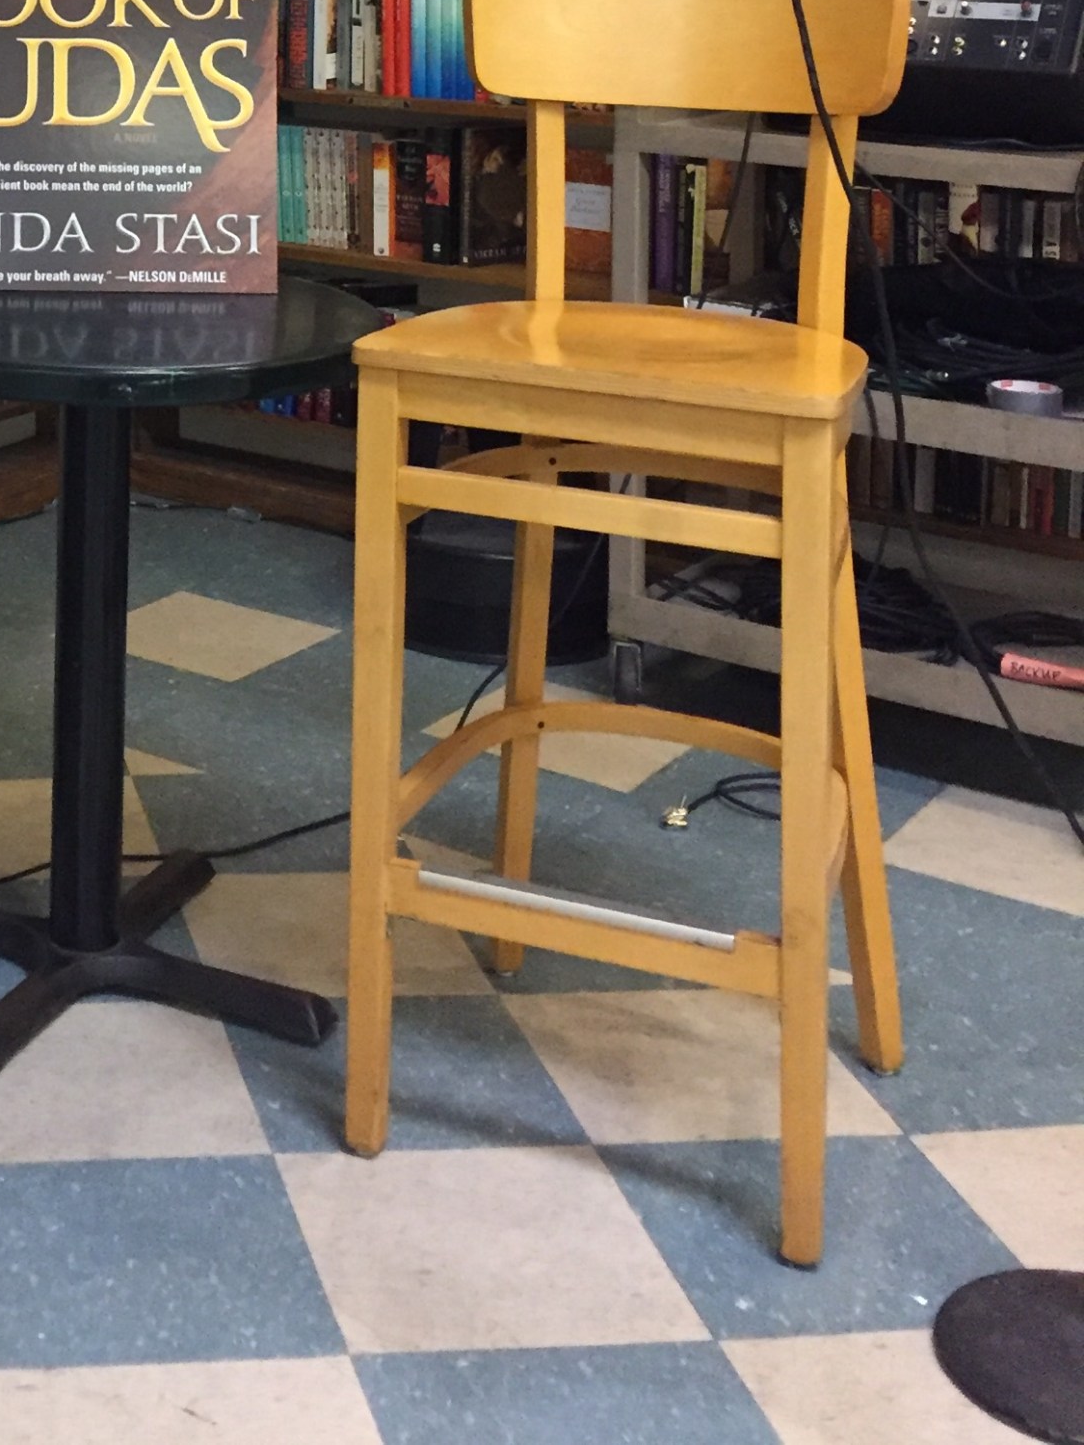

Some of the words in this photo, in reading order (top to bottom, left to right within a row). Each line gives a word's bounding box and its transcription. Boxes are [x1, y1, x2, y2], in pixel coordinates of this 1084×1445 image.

[12, 161, 65, 175] discovery
[67, 161, 79, 173] of
[79, 161, 97, 173] the
[98, 162, 140, 177] missing
[141, 164, 174, 177] pages
[175, 162, 187, 174] of
[188, 164, 202, 174] an
[22, 180, 49, 192] book
[51, 182, 81, 192] mean
[82, 180, 100, 192] the
[102, 181, 122, 193] end
[124, 181, 136, 193] of
[136, 181, 154, 193] the
[155, 182, 193, 194] world?
[115, 212, 262, 255] STASI
[6, 272, 32, 285] your
[33, 270, 71, 283] breath
[1010, 661, 1062, 681] BACKUP
